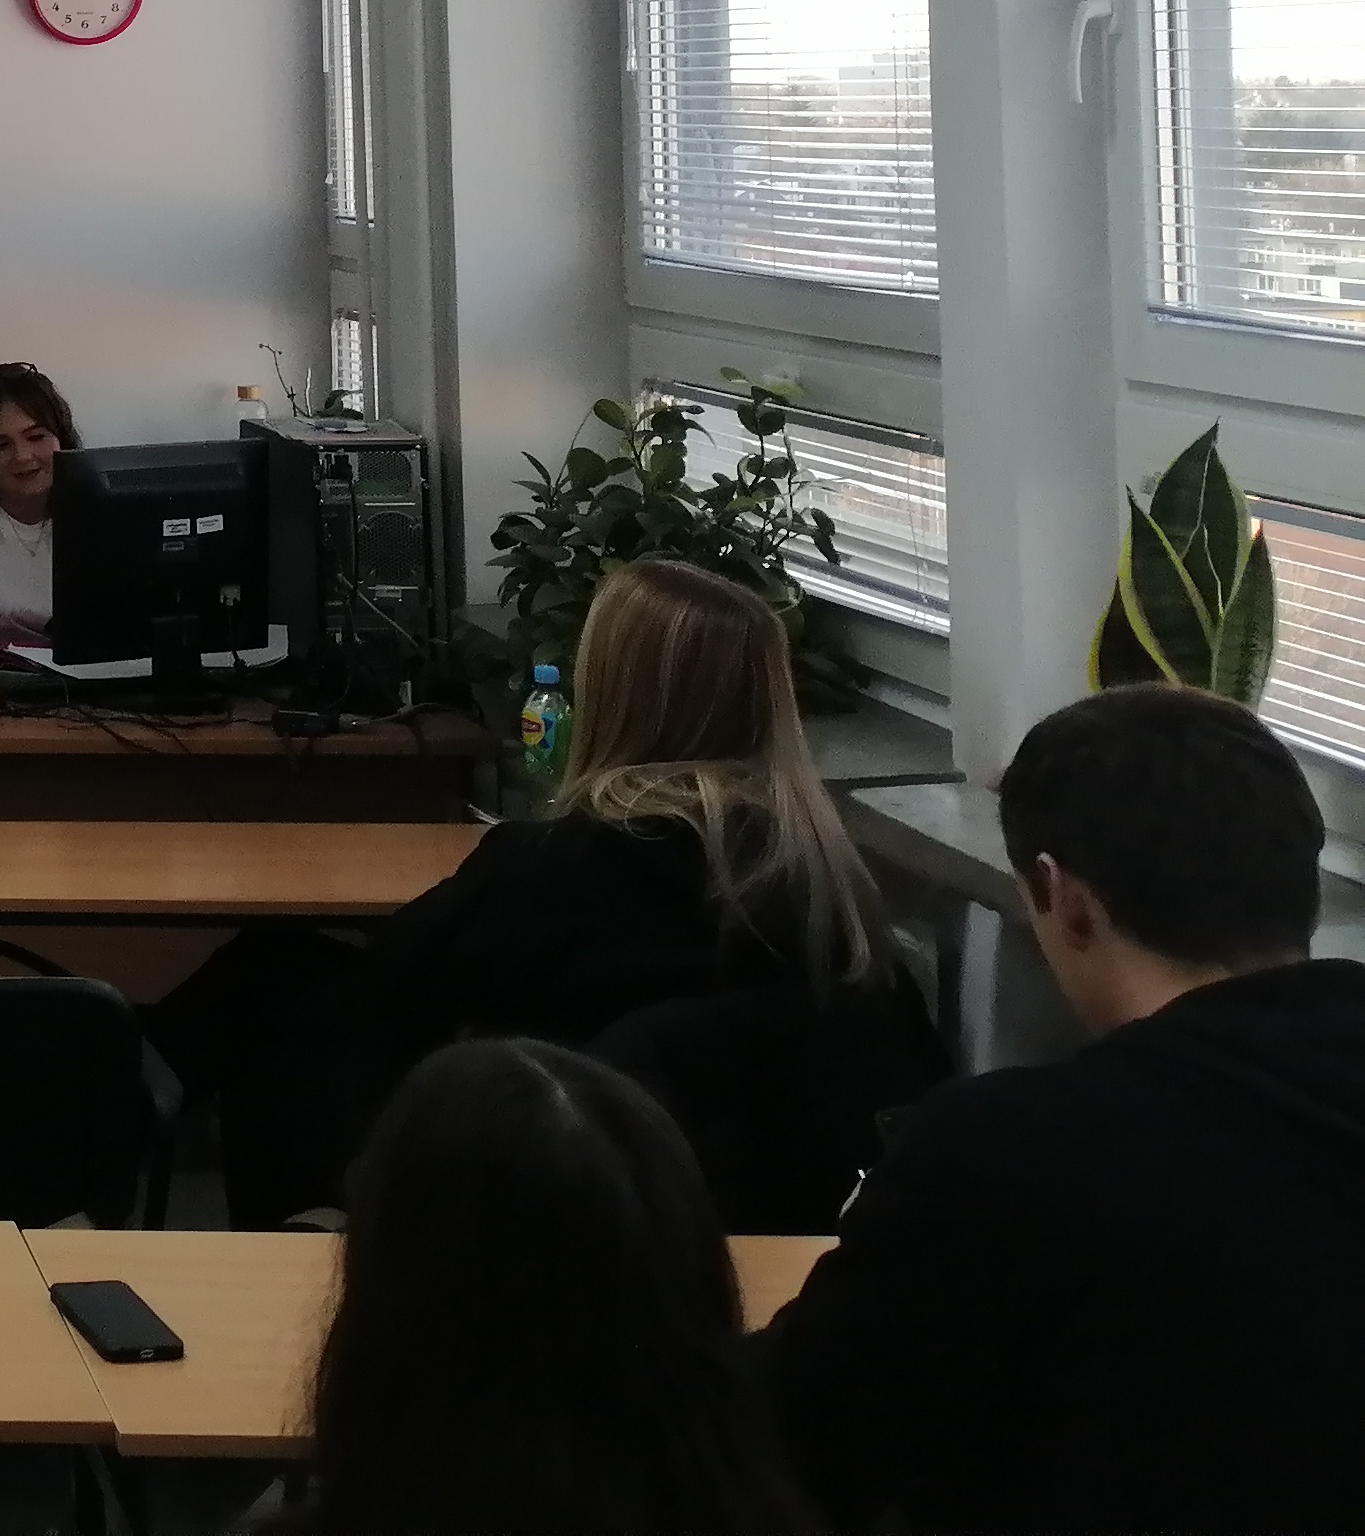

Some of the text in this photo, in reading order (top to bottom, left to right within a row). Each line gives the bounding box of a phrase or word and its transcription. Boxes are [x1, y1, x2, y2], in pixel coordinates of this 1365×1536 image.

[52, 2, 60, 12] 4
[111, 3, 120, 12] 8
[64, 14, 72, 24] 5
[81, 19, 89, 29] 6
[100, 15, 107, 24] 7
